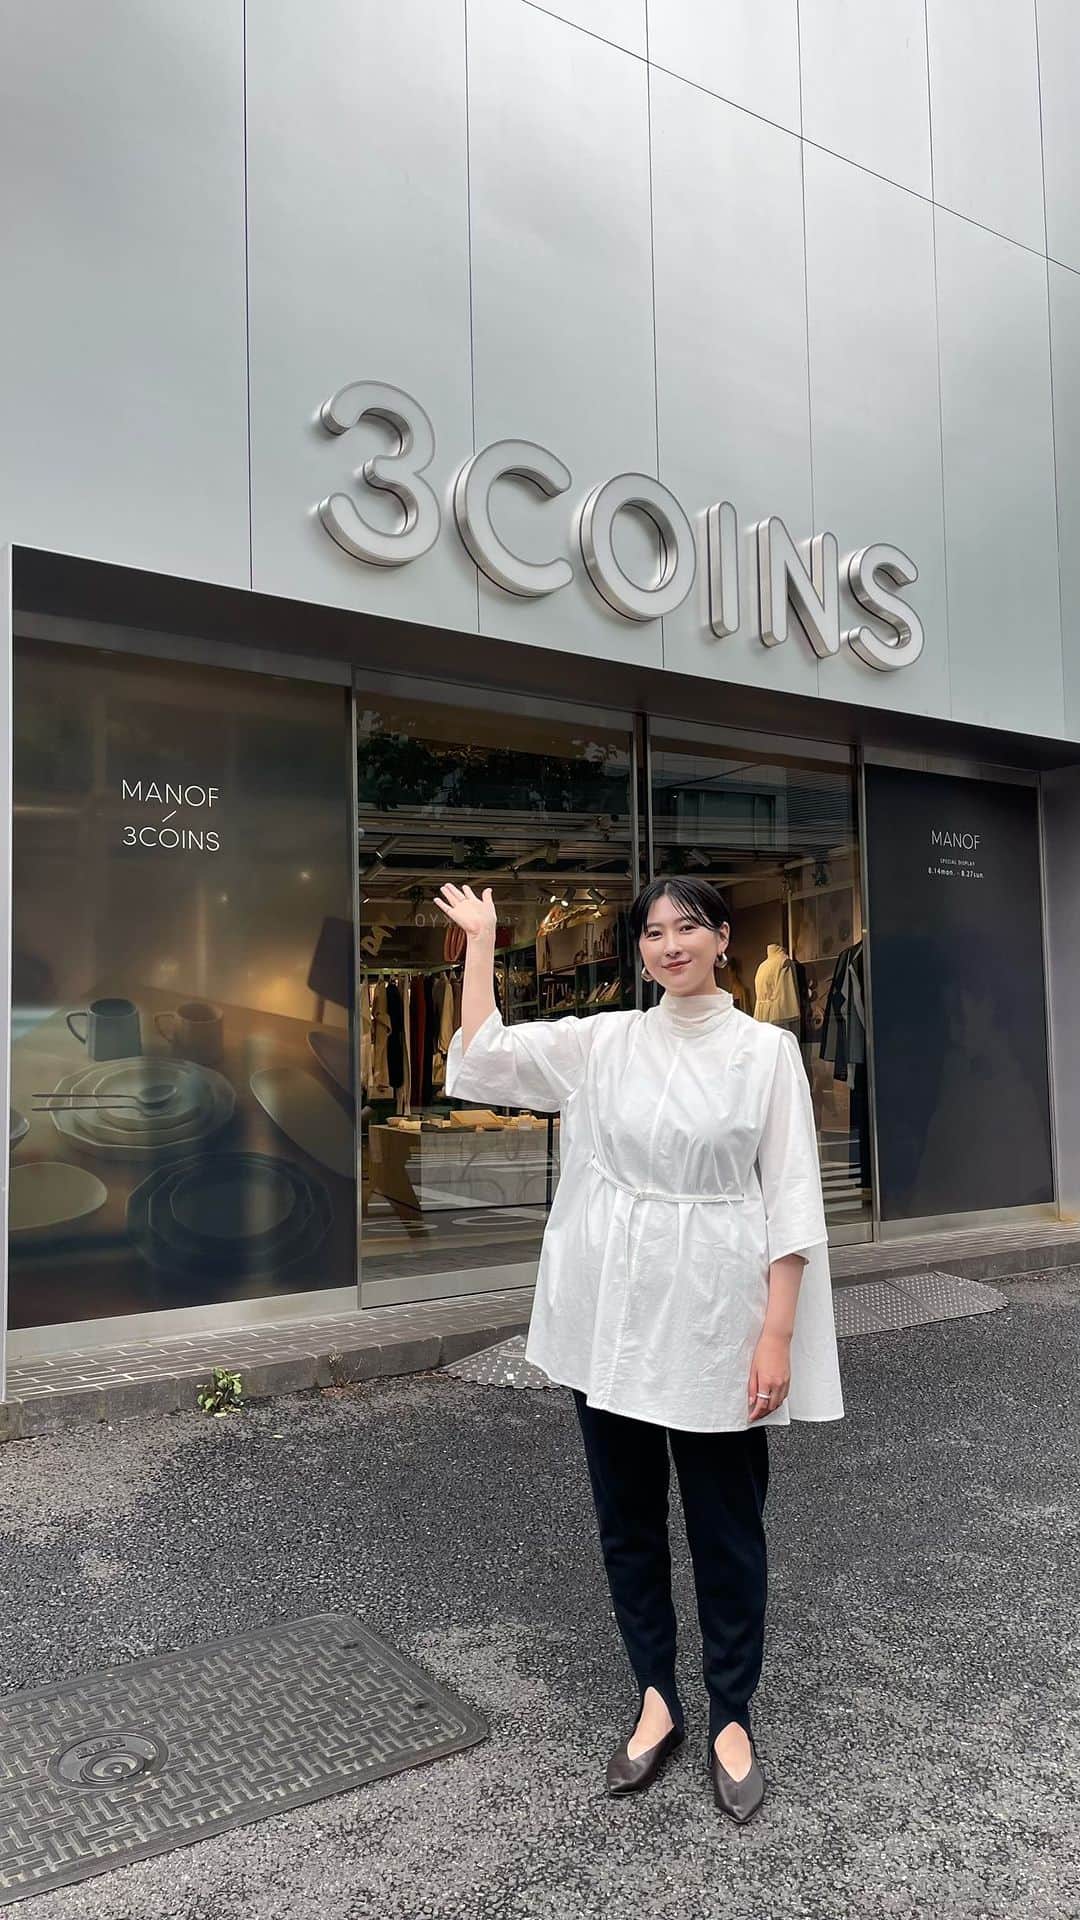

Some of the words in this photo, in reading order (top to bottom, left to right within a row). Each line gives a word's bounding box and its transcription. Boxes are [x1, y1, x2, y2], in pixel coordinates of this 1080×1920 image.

[317, 380, 925, 673] 3COINS
[122, 779, 219, 808] MANOF
[122, 826, 220, 852] 3COINS
[931, 830, 980, 849] MANOF
